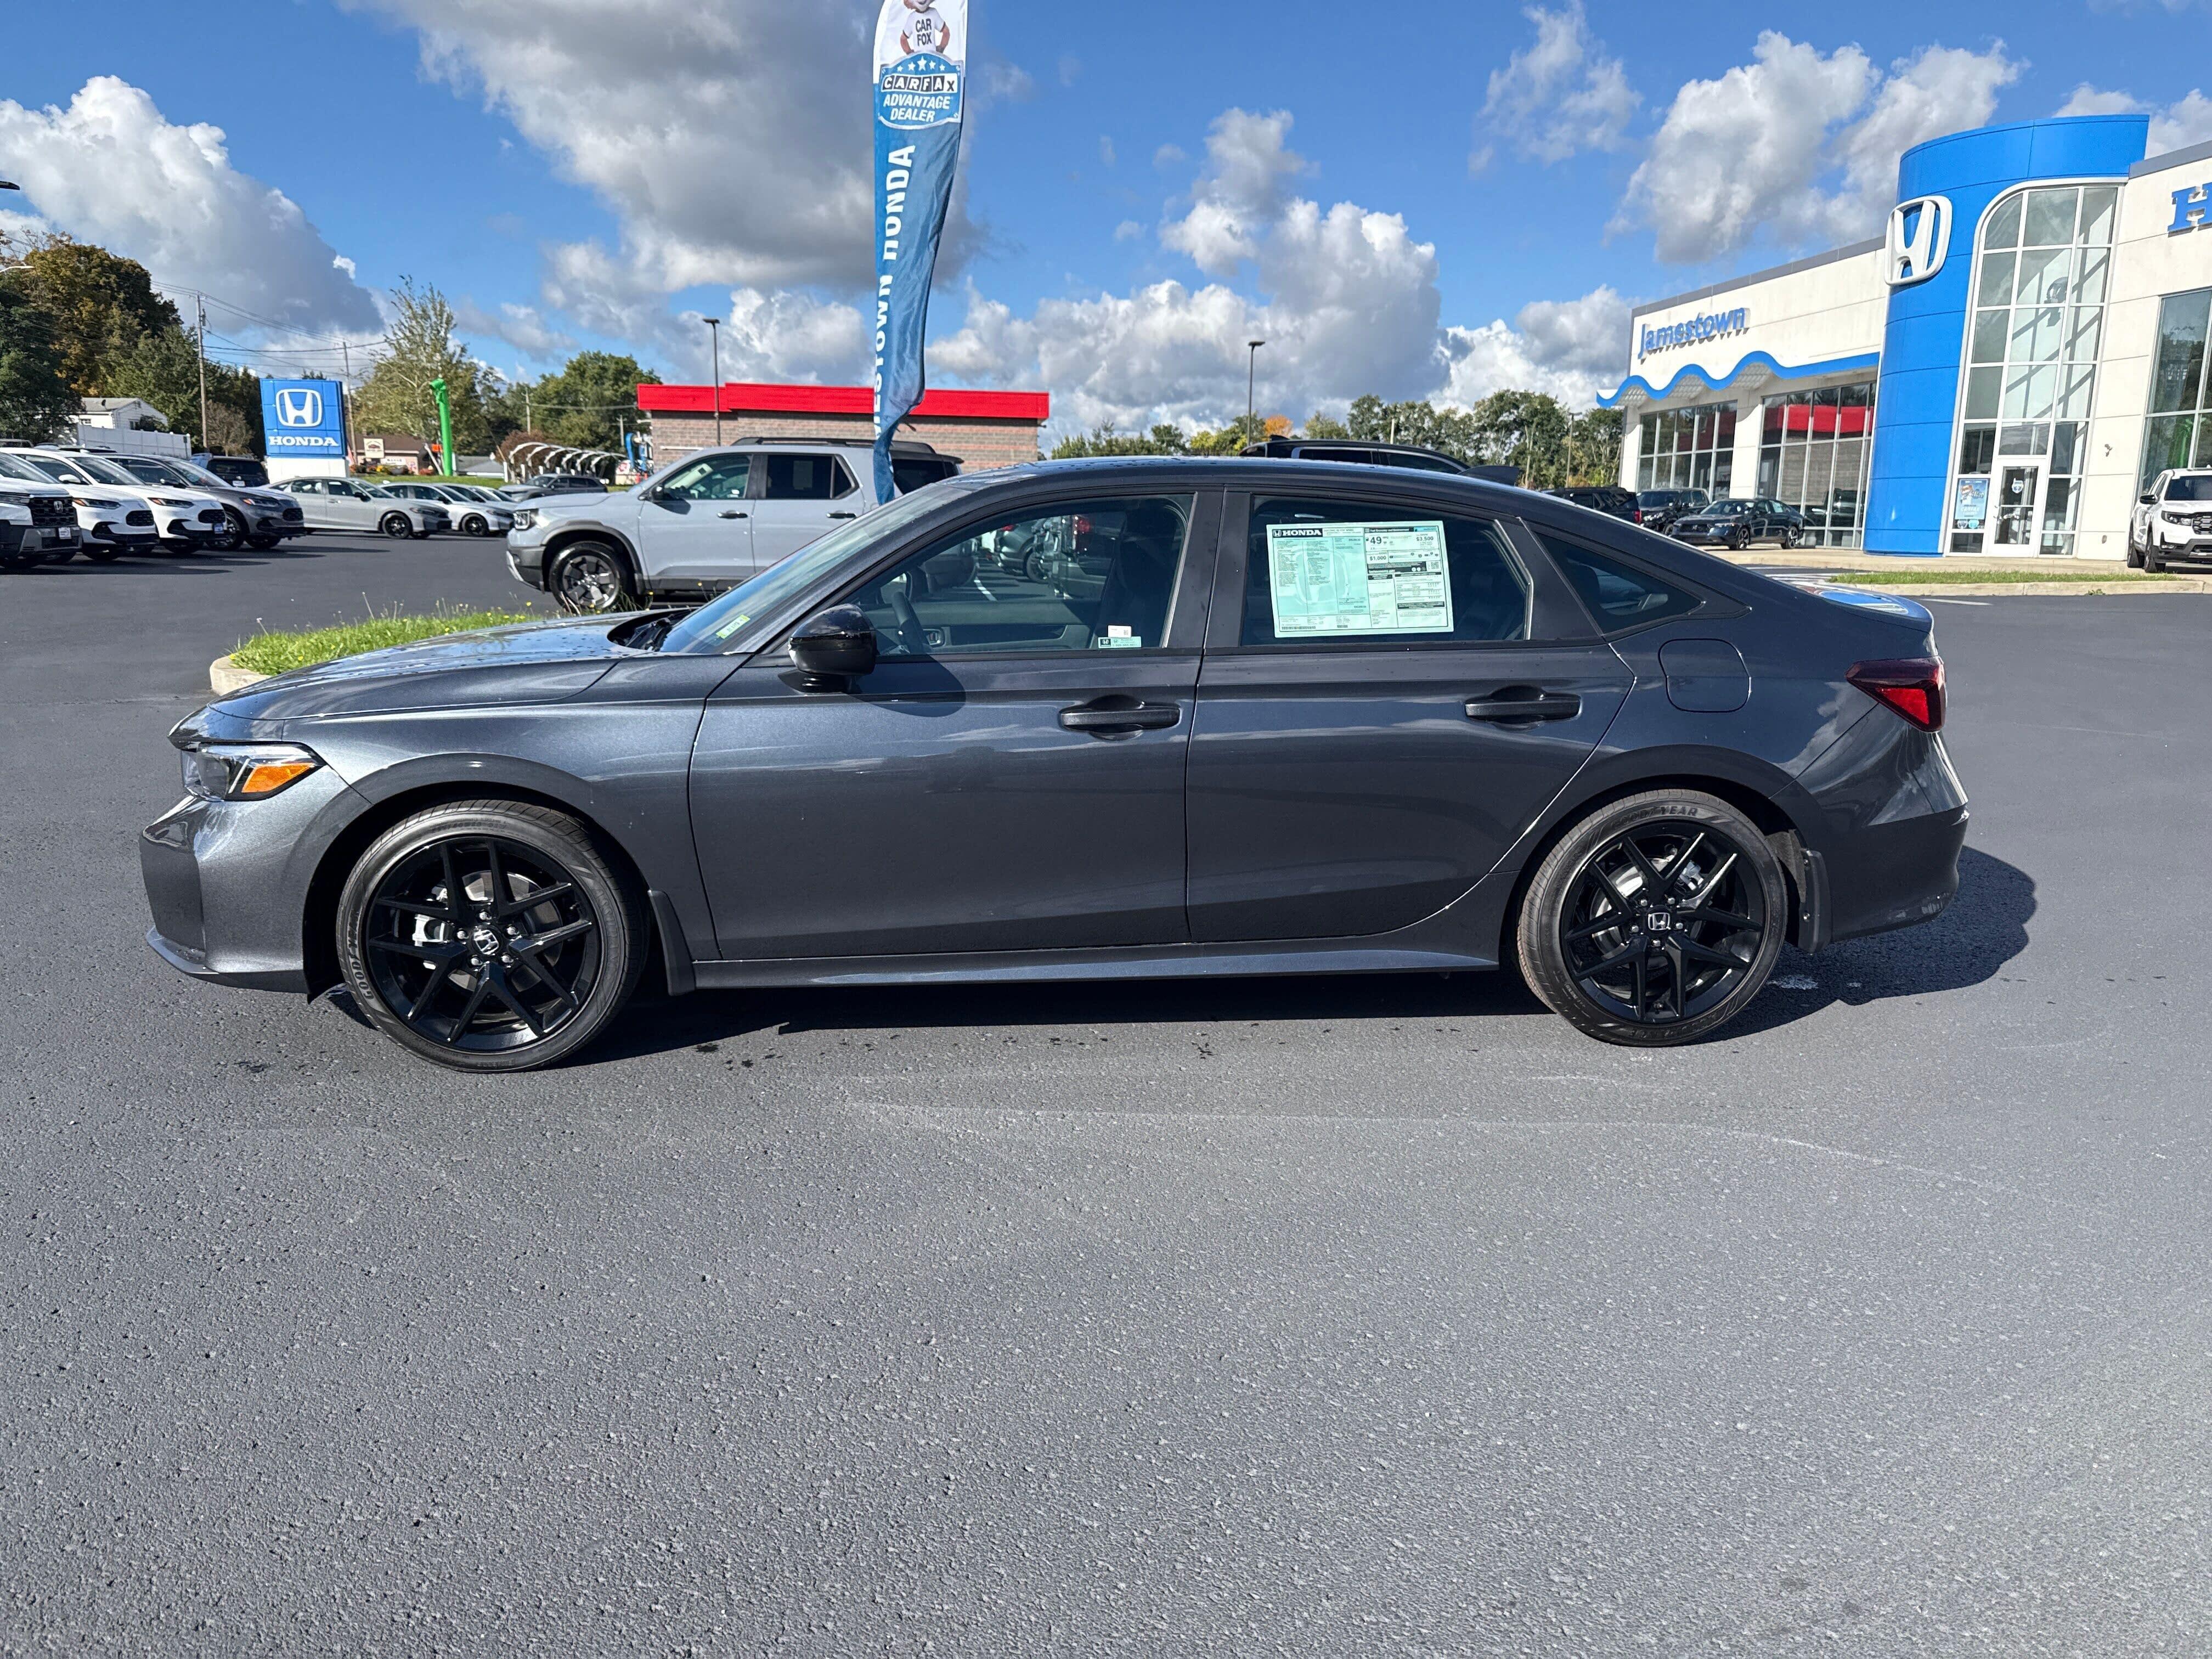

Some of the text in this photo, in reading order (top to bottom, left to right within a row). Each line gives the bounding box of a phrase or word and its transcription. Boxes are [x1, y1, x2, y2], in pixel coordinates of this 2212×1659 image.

[915, 18, 932, 32] CAR
[917, 32, 932, 46] FOX
[882, 75, 955, 92] CARFAX
[883, 94, 951, 109] ADVANTAGE
[890, 109, 936, 122] DEALER
[1637, 307, 1750, 360] Jamestown
[269, 436, 338, 446] HONDA
[1370, 536, 1382, 544] 49
